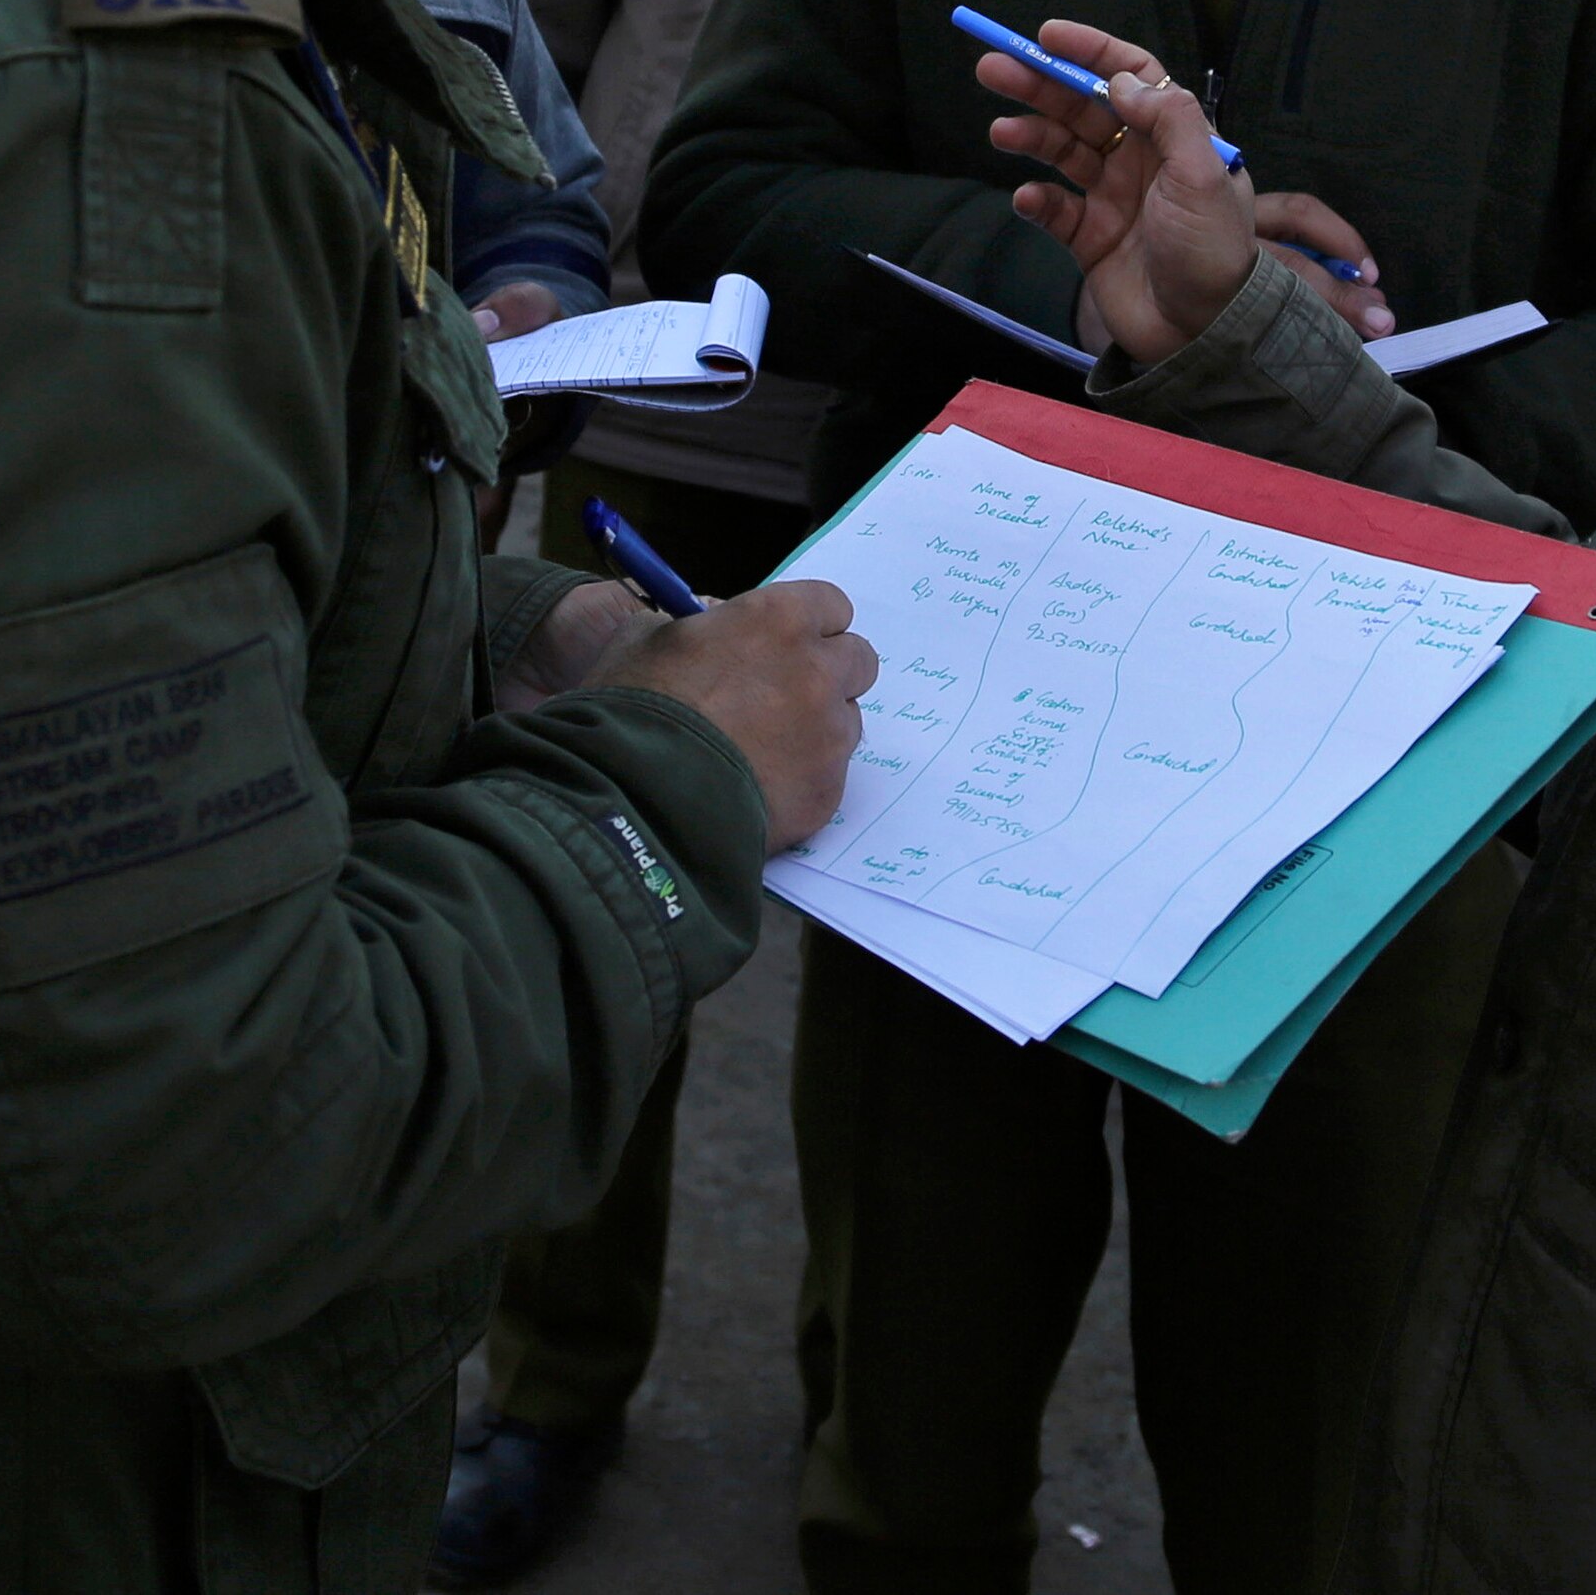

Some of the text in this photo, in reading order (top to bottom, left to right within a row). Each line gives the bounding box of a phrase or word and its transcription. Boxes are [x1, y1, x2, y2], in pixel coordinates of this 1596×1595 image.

[970, 482, 1041, 515] Name of
[1042, 600, 1088, 625] (Son)
[1284, 849, 1315, 871] File
